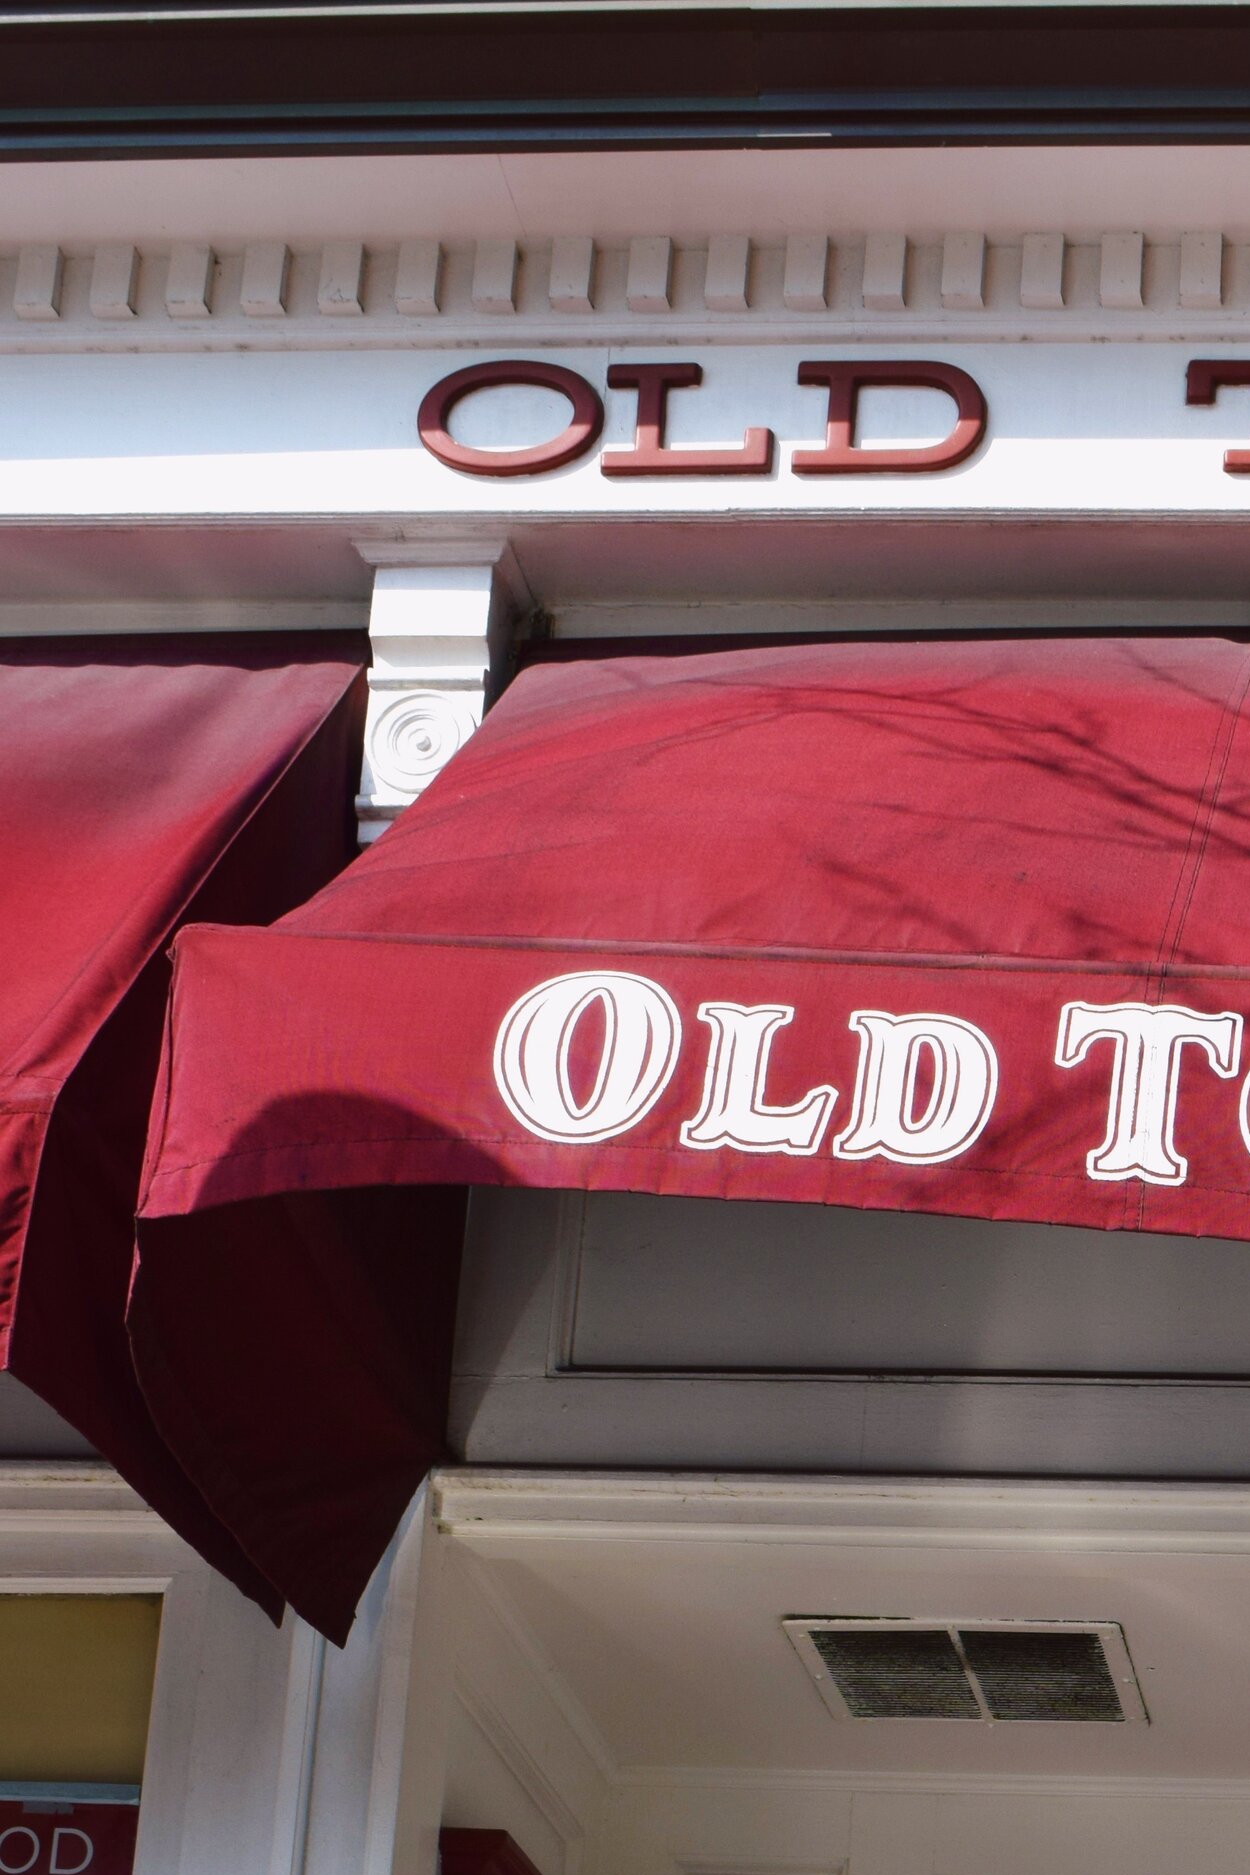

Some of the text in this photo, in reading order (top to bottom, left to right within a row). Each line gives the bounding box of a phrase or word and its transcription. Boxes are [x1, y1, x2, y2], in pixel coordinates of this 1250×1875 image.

[417, 360, 988, 476] OLD
[493, 970, 998, 1165] OLD
[0, 1826, 94, 1875] OD
